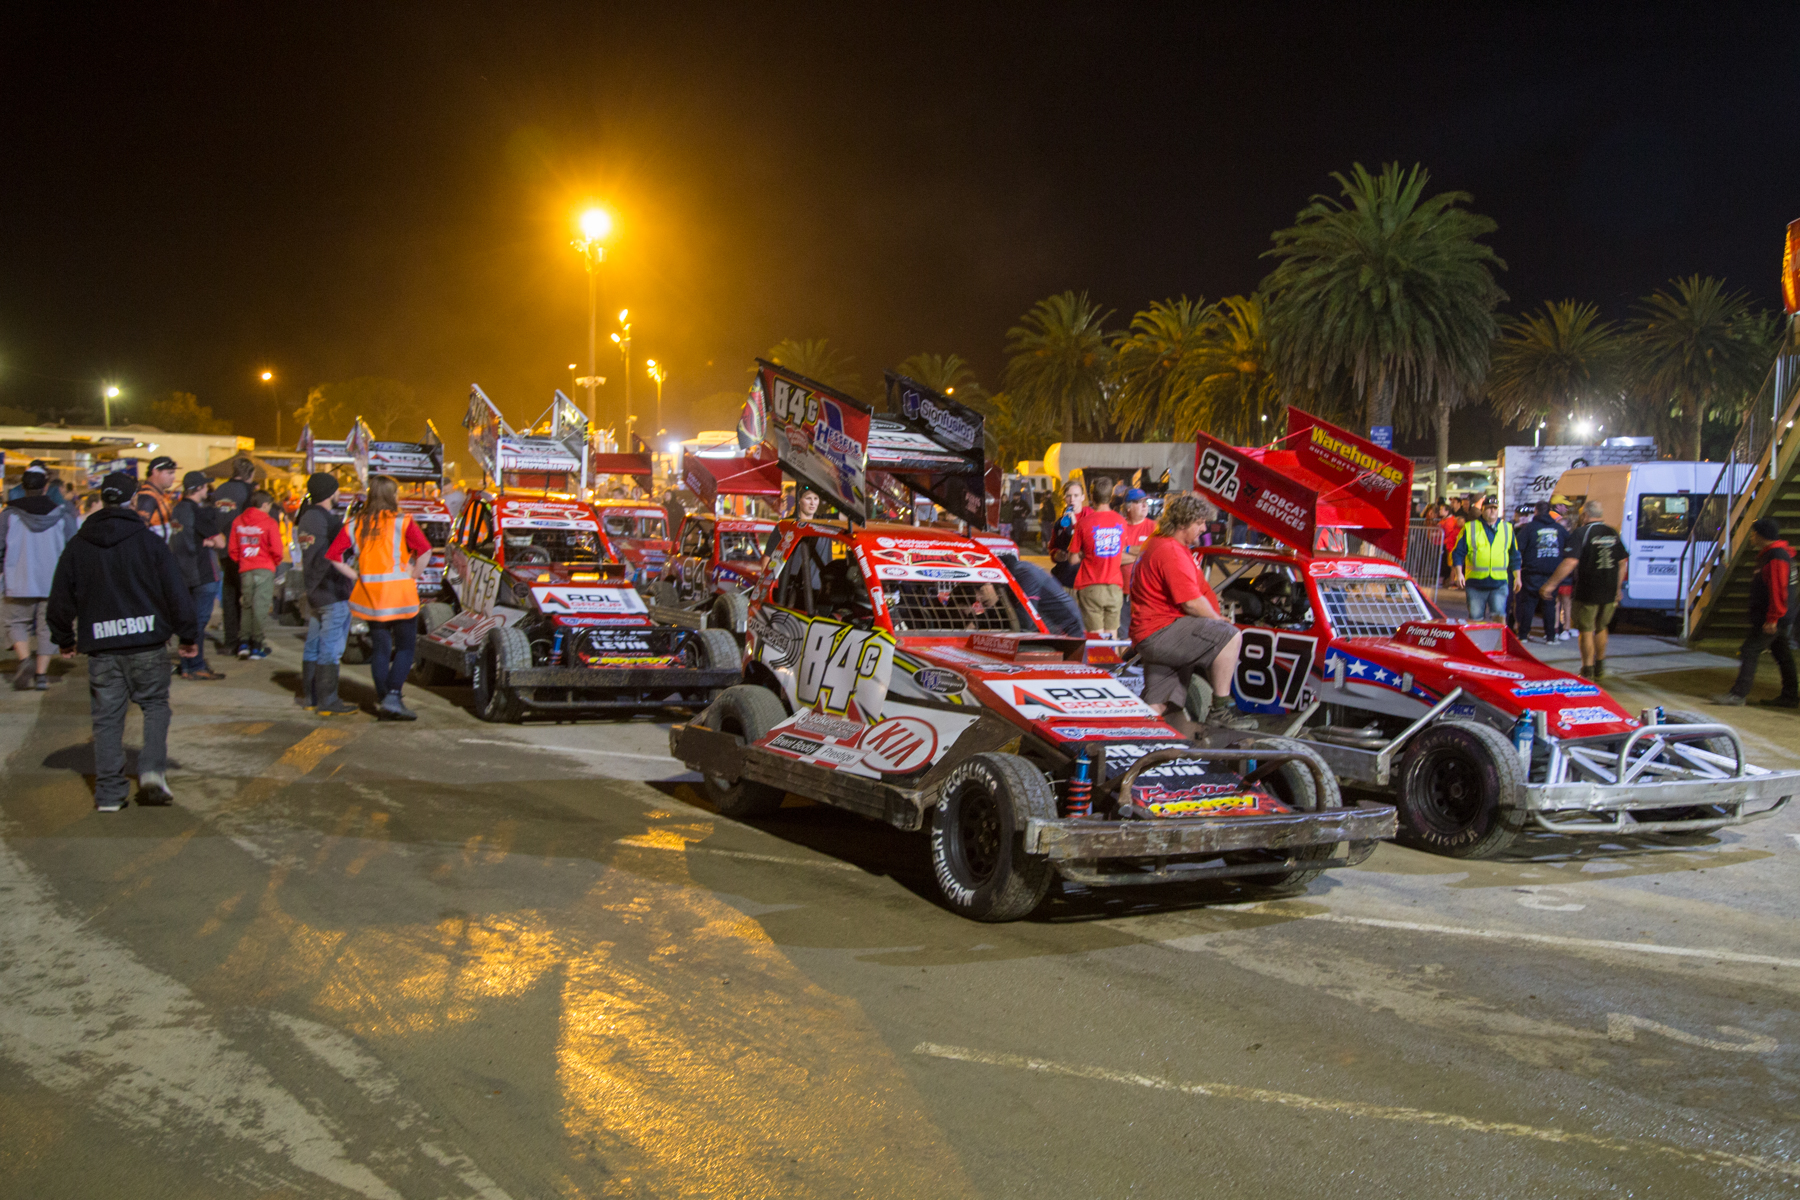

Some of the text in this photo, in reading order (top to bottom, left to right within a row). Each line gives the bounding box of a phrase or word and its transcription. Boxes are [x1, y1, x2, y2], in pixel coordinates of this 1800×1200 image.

[921, 399, 975, 441] Signfusion
[1309, 446, 1356, 472] auto parts
[1312, 427, 1404, 485] Warehouse
[1255, 499, 1306, 531] SERVICES
[1261, 489, 1307, 518] BOBCAT
[567, 594, 620, 603] RDL
[93, 615, 156, 640] RMCBOY
[1406, 626, 1455, 639] Prime Home
[592, 641, 649, 650] LEVIN
[1418, 637, 1437, 647] Kills
[1043, 687, 1131, 701] RDL
[1061, 701, 1139, 710] GROUP
[772, 735, 856, 763] Brent Boddy Prestige
[866, 722, 926, 768] KIA
[931, 826, 976, 906] MACHINERY
